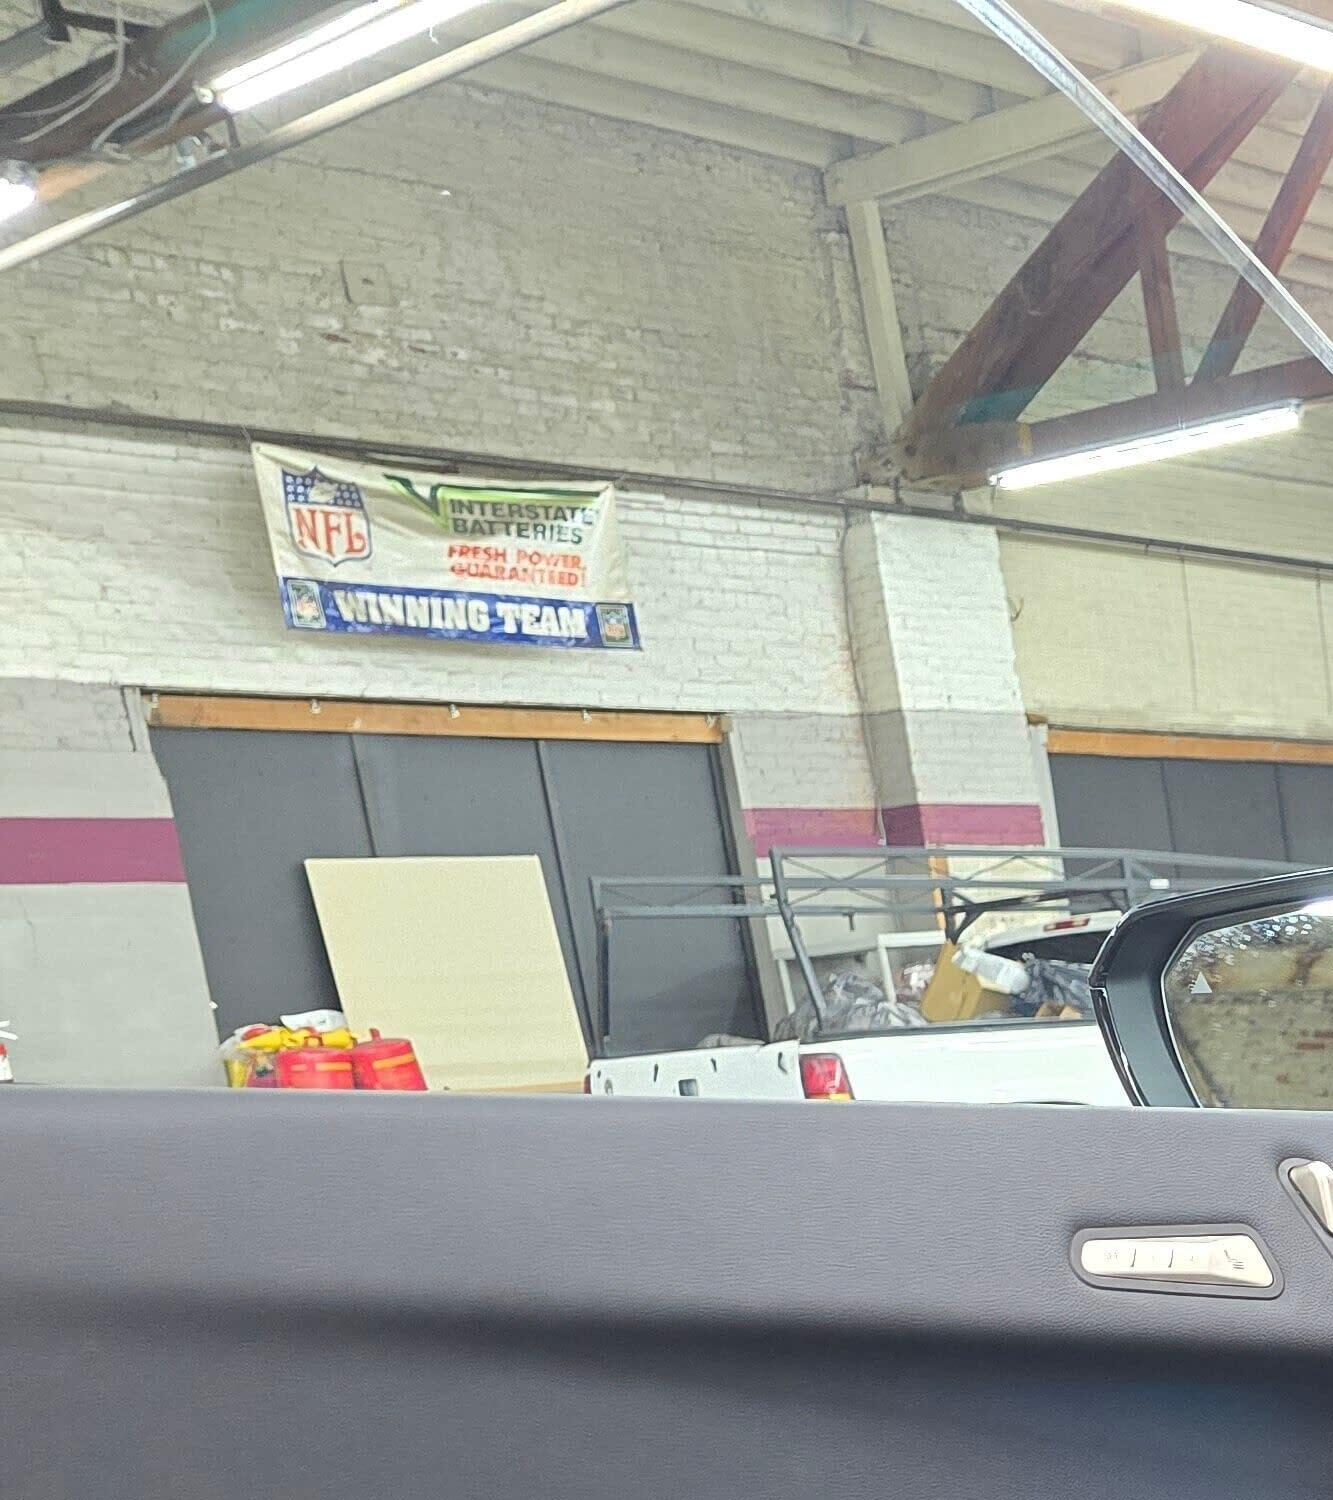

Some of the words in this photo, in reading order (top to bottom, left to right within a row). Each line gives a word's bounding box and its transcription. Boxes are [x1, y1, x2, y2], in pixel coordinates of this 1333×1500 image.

[450, 499, 599, 526] INTERSTATE
[295, 509, 368, 555] NFL
[453, 516, 583, 545] BATTERIES
[448, 544, 507, 564] FRESH
[333, 589, 490, 631] WINNING
[495, 602, 589, 638] TEAM
